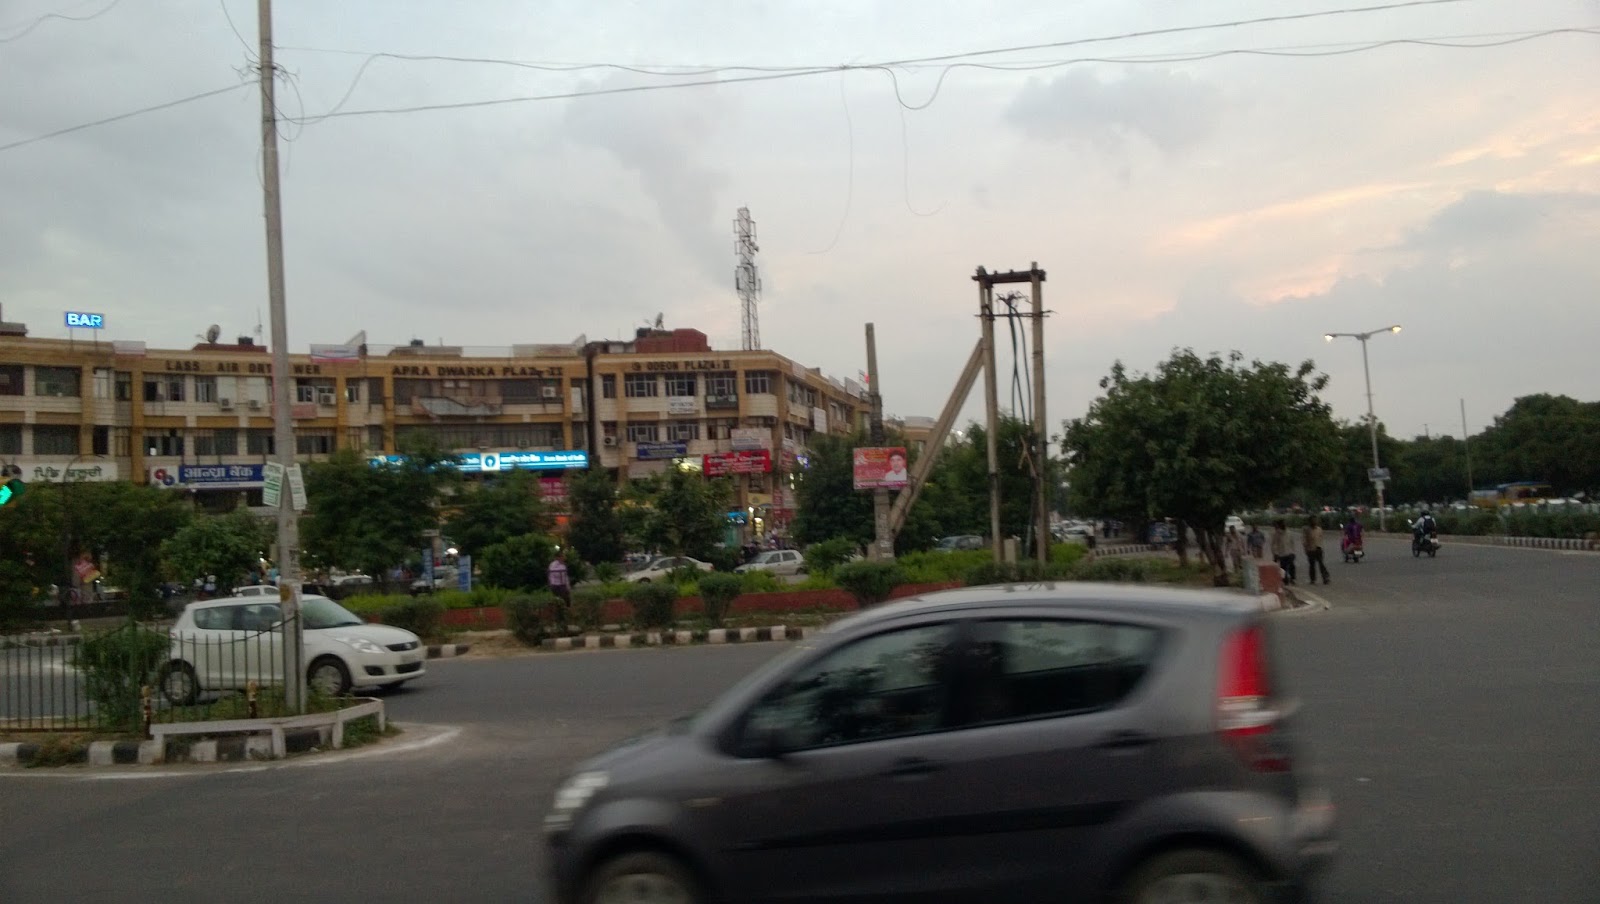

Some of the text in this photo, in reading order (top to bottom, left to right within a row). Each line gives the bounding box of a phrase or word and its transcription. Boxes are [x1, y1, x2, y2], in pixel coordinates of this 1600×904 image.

[67, 313, 102, 327] BAR
[217, 362, 240, 372] AIR
[293, 364, 321, 375] WER
[392, 365, 430, 376] APRA
[437, 366, 495, 376] DWARKA
[646, 361, 679, 370] ODEON
